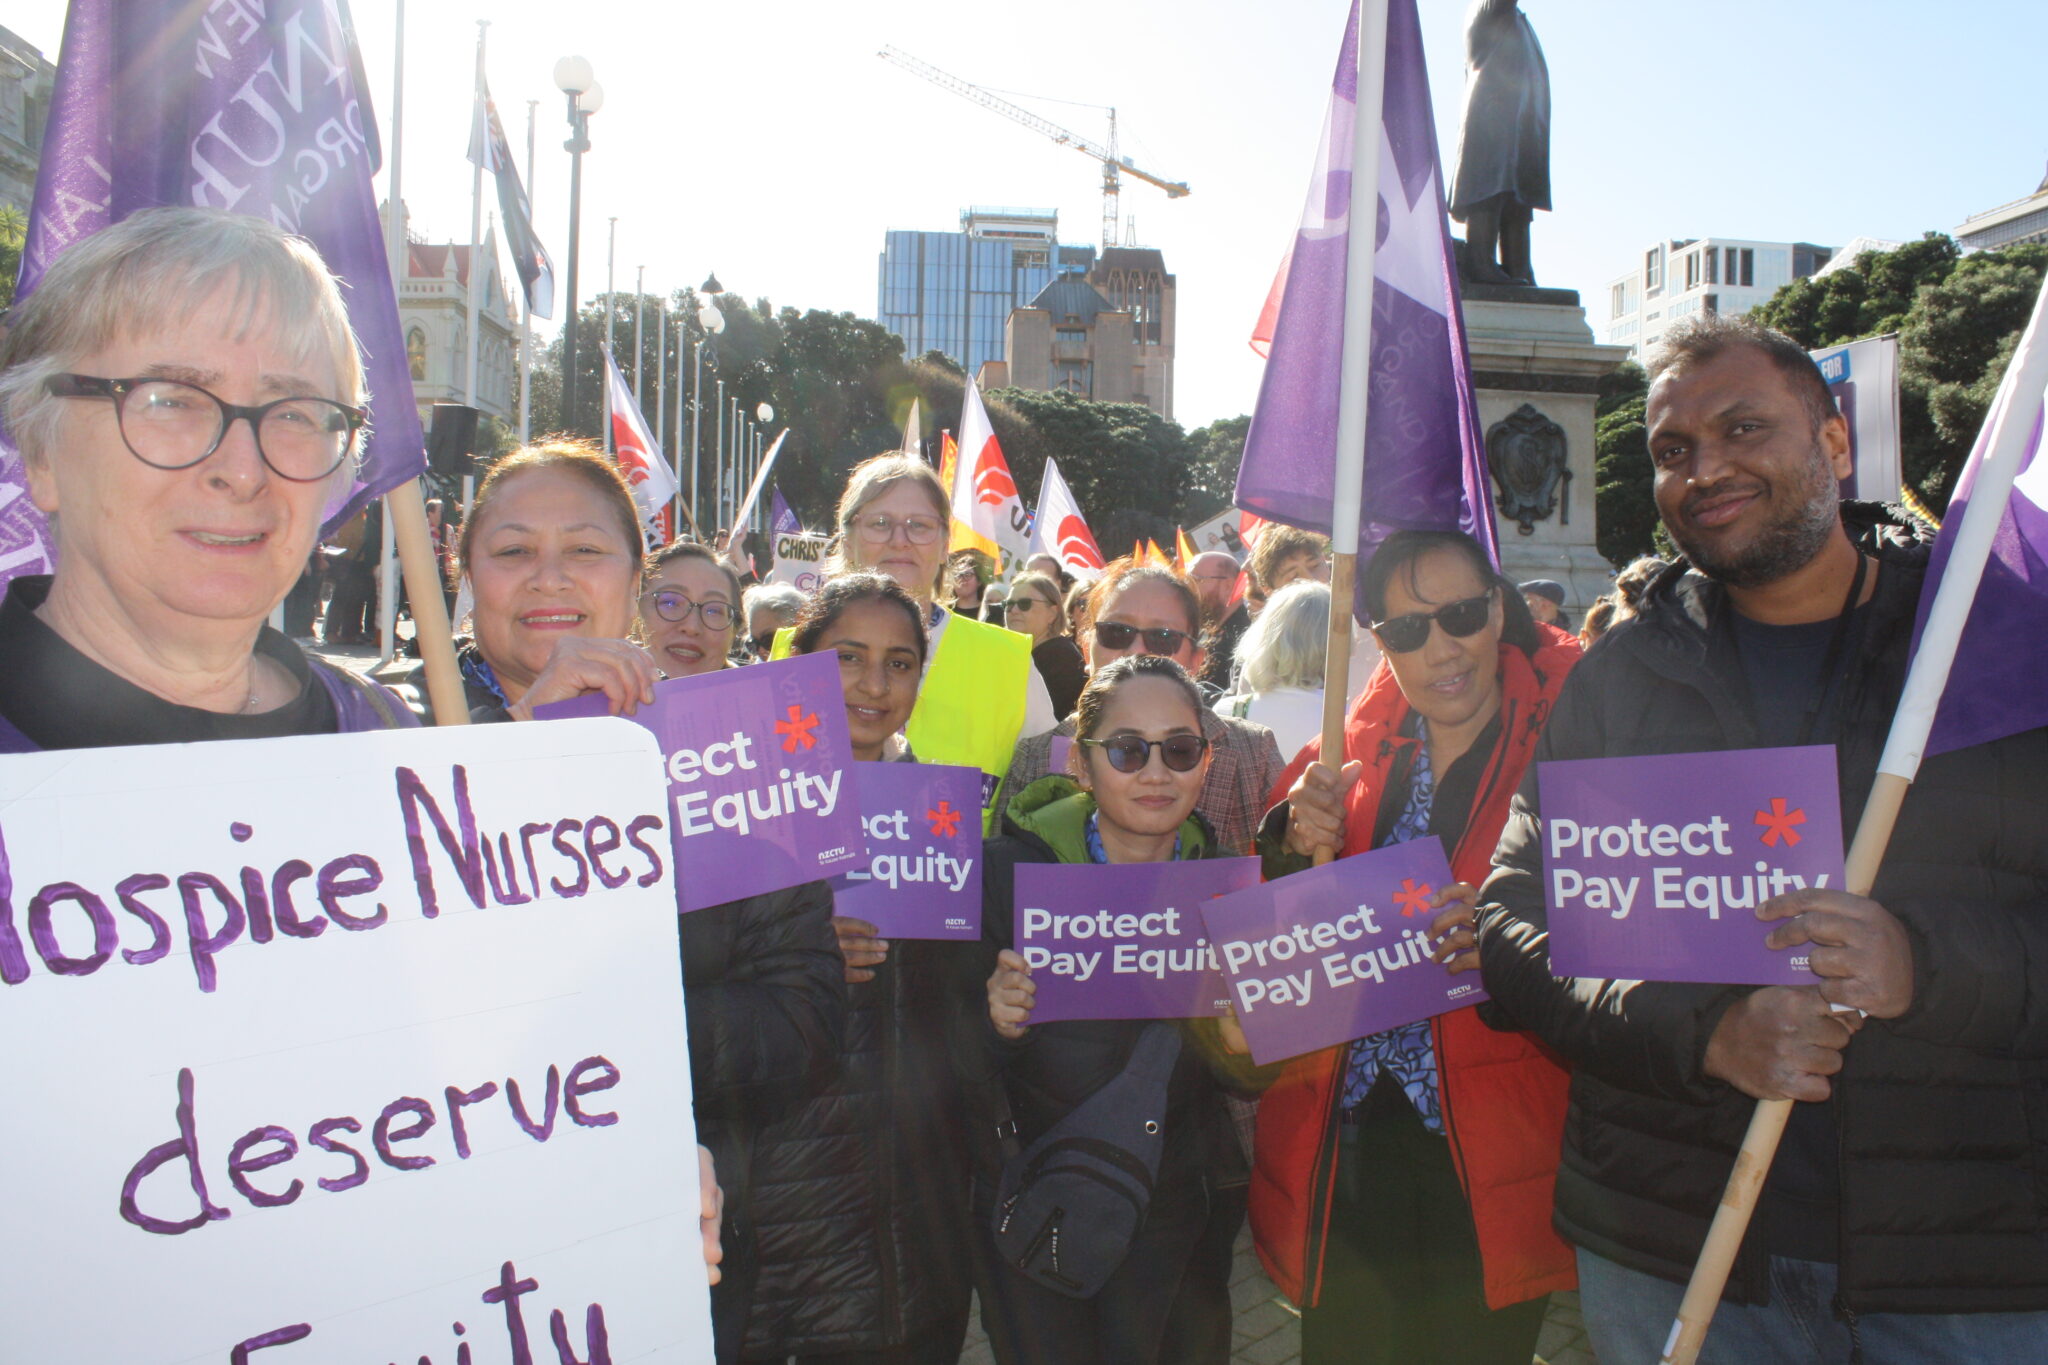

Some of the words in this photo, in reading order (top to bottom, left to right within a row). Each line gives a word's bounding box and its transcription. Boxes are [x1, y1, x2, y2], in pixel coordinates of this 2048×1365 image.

[1821, 356, 1842, 379] FOR
[676, 768, 842, 837] Equity
[395, 764, 663, 918] Nurses
[1550, 815, 1733, 858] Protect
[1553, 868, 1640, 920] Pay
[1023, 907, 1181, 939] Protect
[1222, 904, 1382, 975] Protect
[1023, 946, 1103, 981] Pay
[1112, 938, 1223, 979] Equit
[1236, 968, 1313, 1014] Pay
[120, 1055, 620, 1235] deserve
